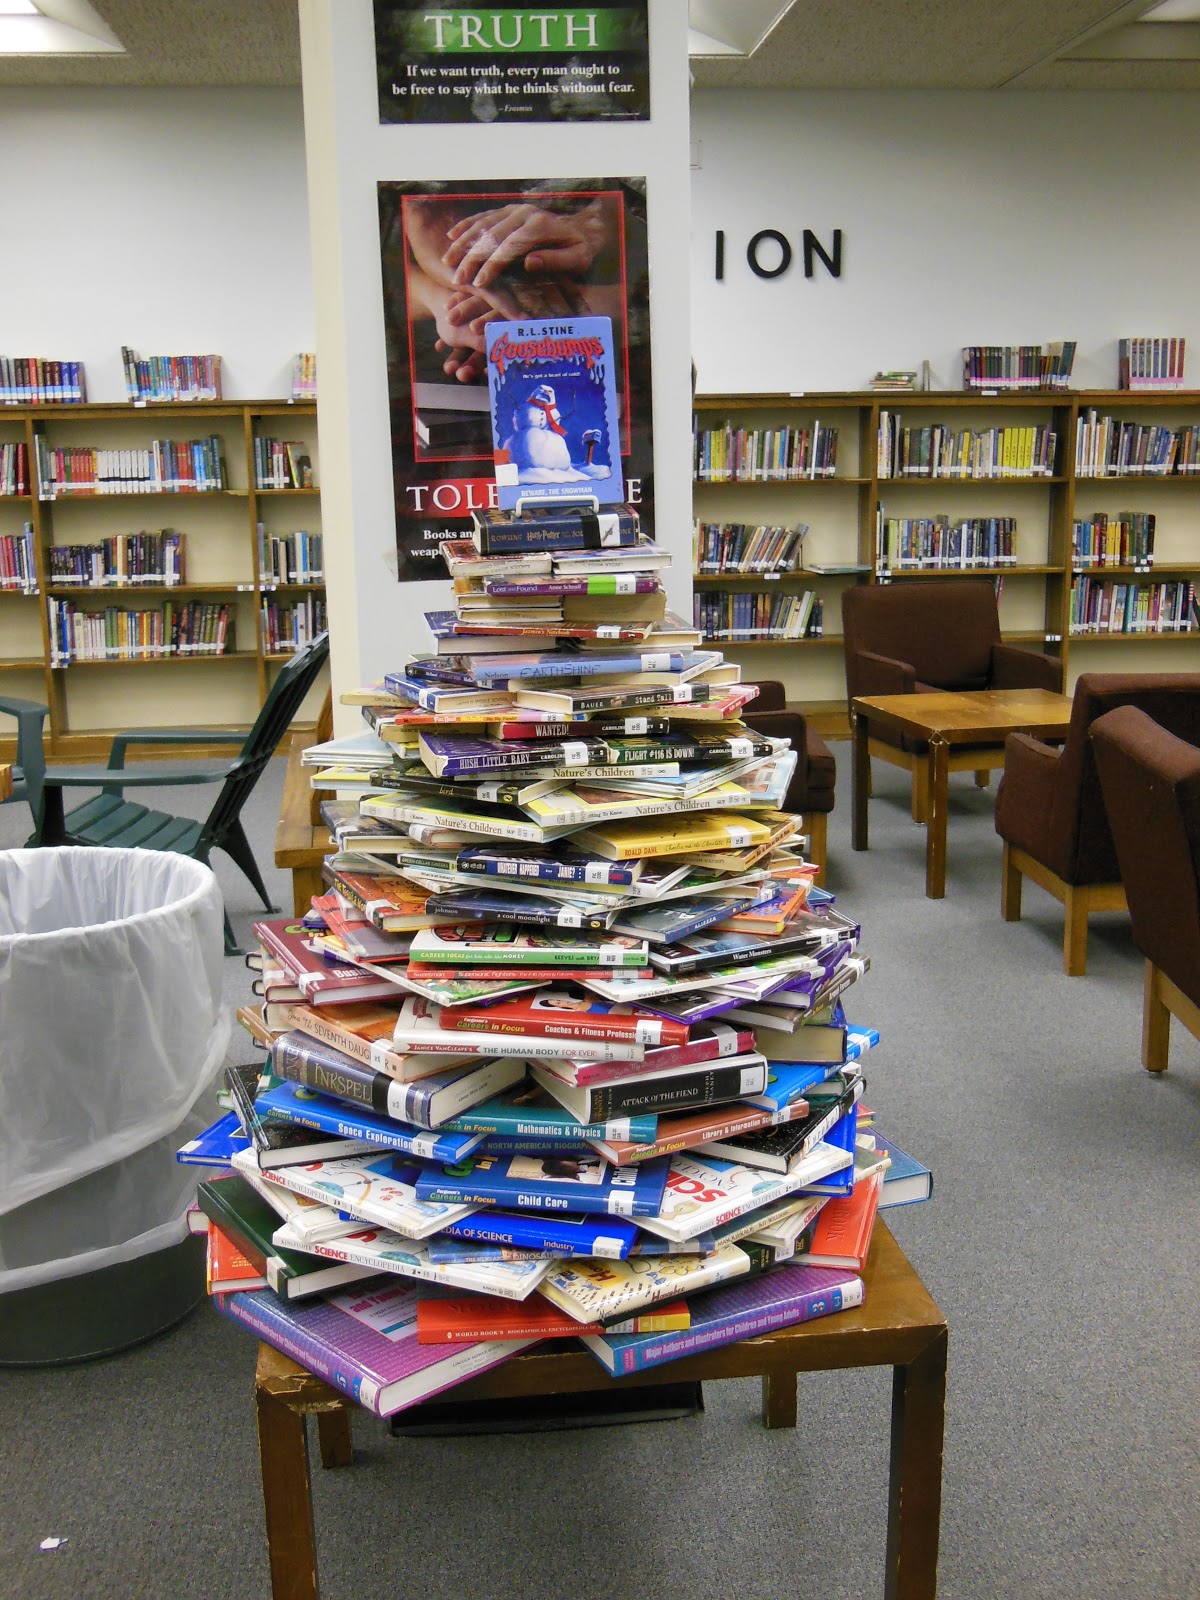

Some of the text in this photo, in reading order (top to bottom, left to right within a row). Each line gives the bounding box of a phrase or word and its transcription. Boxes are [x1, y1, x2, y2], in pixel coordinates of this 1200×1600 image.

[424, 14, 599, 48] TRUTH
[406, 64, 621, 79] If we want truth, every man ought to
[392, 81, 635, 97] be free to say what he thinks without fear.
[490, 332, 605, 376] Goosebumps
[521, 486, 592, 497] BEWARE, THE SNOWMAN
[423, 529, 457, 540] Books
[526, 530, 542, 541] Harry
[542, 529, 560, 541] Potter
[410, 549, 441, 559] weap
[516, 585, 538, 593] Found
[485, 671, 509, 680] Nelson
[519, 664, 601, 678] EARTHSHINE
[581, 692, 673, 709] BAUER Stand Tall
[535, 723, 570, 737] WANTED!
[459, 758, 479, 769] HUSH
[482, 756, 508, 767] LITTLE
[511, 754, 530, 765] BABY
[624, 750, 648, 762] FLIGHT
[649, 750, 664, 761] #116
[665, 749, 673, 759] IS
[673, 748, 695, 759] DOWN!
[553, 767, 635, 778] Nature's Children
[636, 802, 672, 815] Nature's
[674, 799, 710, 811] Children
[435, 816, 502, 834] Nature's Children
[624, 848, 643, 857] ROALD
[644, 846, 658, 855] DAHL
[519, 863, 540, 876] HAPPENED
[434, 907, 458, 915] johnson
[502, 912, 516, 920] cool
[517, 913, 551, 924] moonlight
[733, 949, 772, 961] Water Monsters
[314, 1023, 347, 1048] SEVENTH
[456, 1021, 489, 1030] Careers
[501, 1024, 526, 1033] Focus
[544, 1025, 572, 1035] Coaches
[574, 1027, 580, 1035] &
[581, 1028, 605, 1038] Fitness
[607, 1029, 636, 1039] Professi
[414, 1044, 433, 1052] JANICE
[483, 1047, 499, 1055] THE
[500, 1047, 534, 1055] HUMAN
[621, 1096, 649, 1107] ATTACK
[660, 1091, 674, 1100] THE
[675, 1088, 698, 1098] FIEND
[266, 1110, 293, 1121] Careers
[301, 1118, 321, 1128] Focus
[338, 1123, 363, 1138] Space
[366, 1129, 412, 1149] Exploration
[464, 1123, 601, 1138] in Focus Mathematics & Physics
[666, 1141, 686, 1151] Focus
[702, 1129, 723, 1140] Library
[725, 1126, 730, 1134] &
[731, 1119, 761, 1132] Information
[488, 1141, 590, 1150] NORTH AMERICAN BIOGRAP
[261, 1170, 329, 1203] SCIENCE ENCYCLOPEDIA
[429, 1192, 462, 1201] Careers
[473, 1195, 497, 1204] Focus
[517, 1194, 543, 1206] Child
[545, 1197, 568, 1208] Care
[716, 1206, 741, 1225] SCIENCE
[464, 1228, 475, 1238] OF
[477, 1229, 513, 1243] SCIENCE
[543, 1239, 575, 1251] Industry
[314, 1245, 348, 1260] SCIENCE
[350, 1253, 405, 1273] ENCYCLOPEDIA
[646, 1308, 799, 1359] Major Authors and Illustrators for Children and Young Adults
